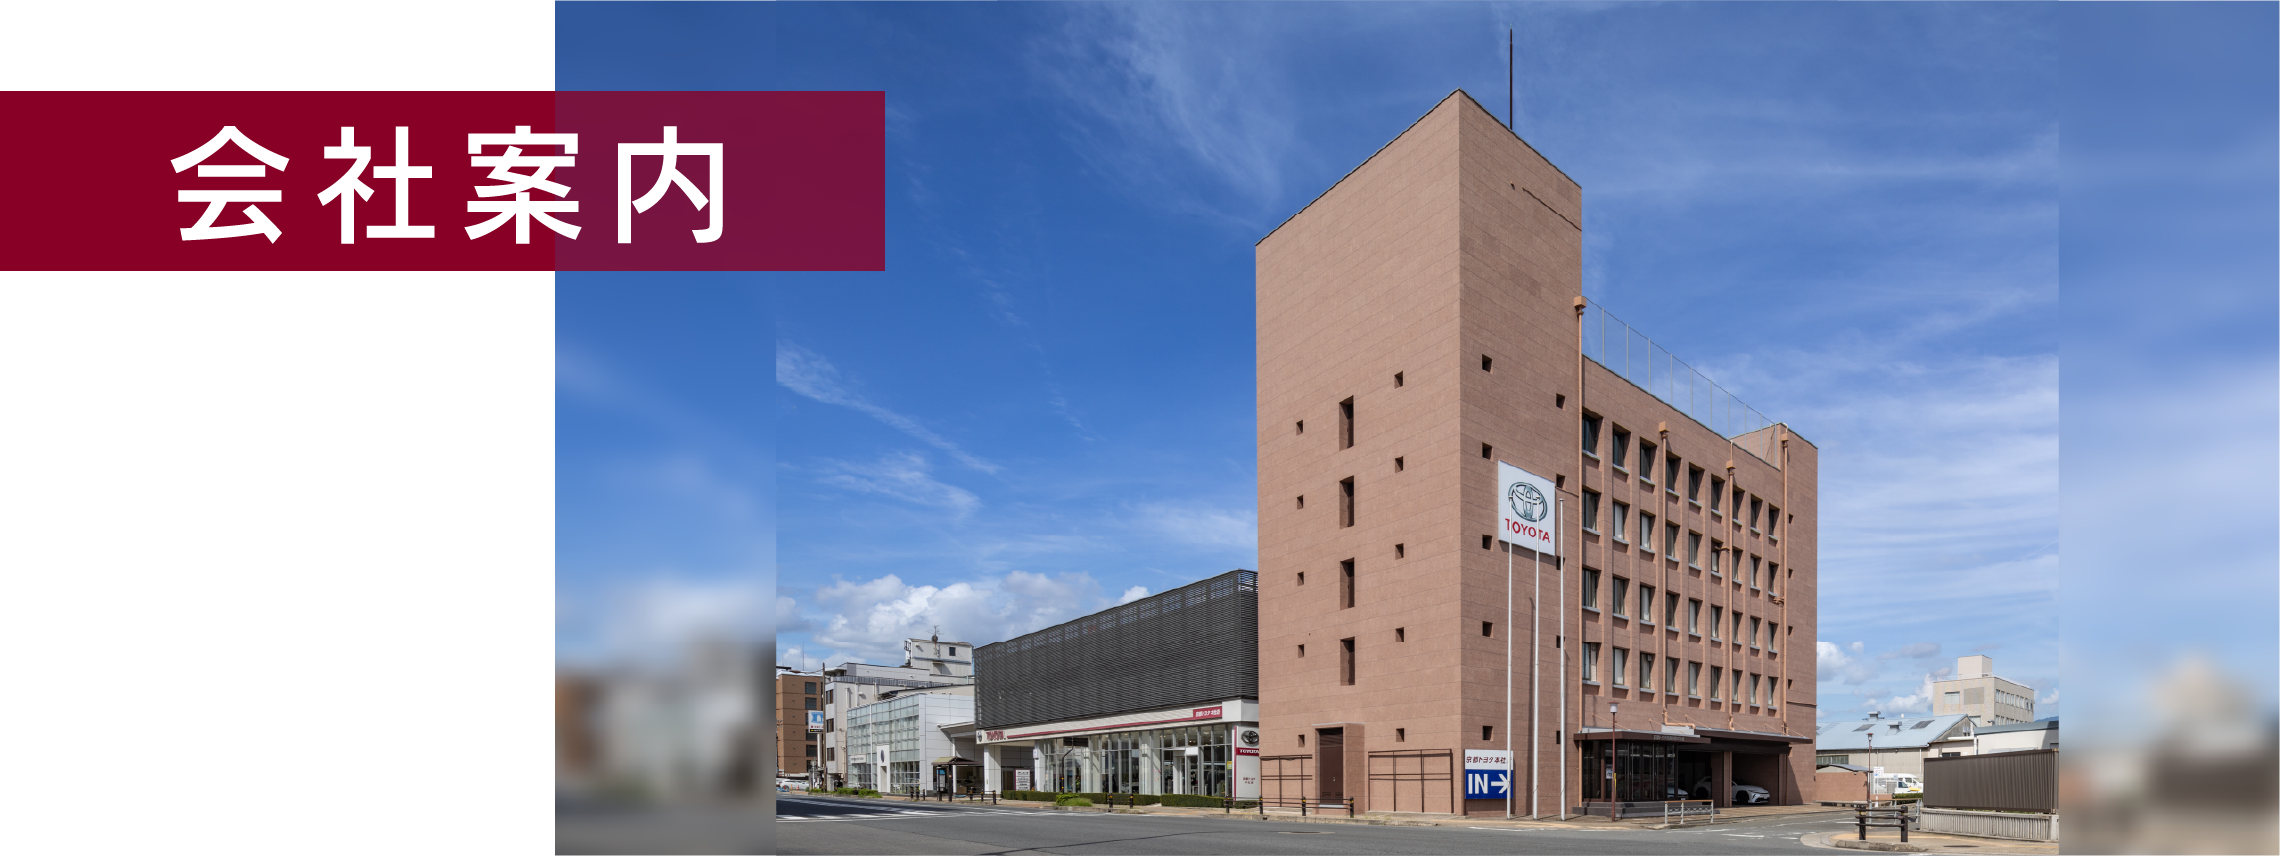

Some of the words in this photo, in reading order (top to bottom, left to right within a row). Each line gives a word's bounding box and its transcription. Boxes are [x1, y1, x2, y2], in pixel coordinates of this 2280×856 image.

[1505, 518, 1551, 544] TOYOTA
[1465, 755, 1512, 764] 京都トヨタ本社
[1468, 773, 1488, 794] IN
